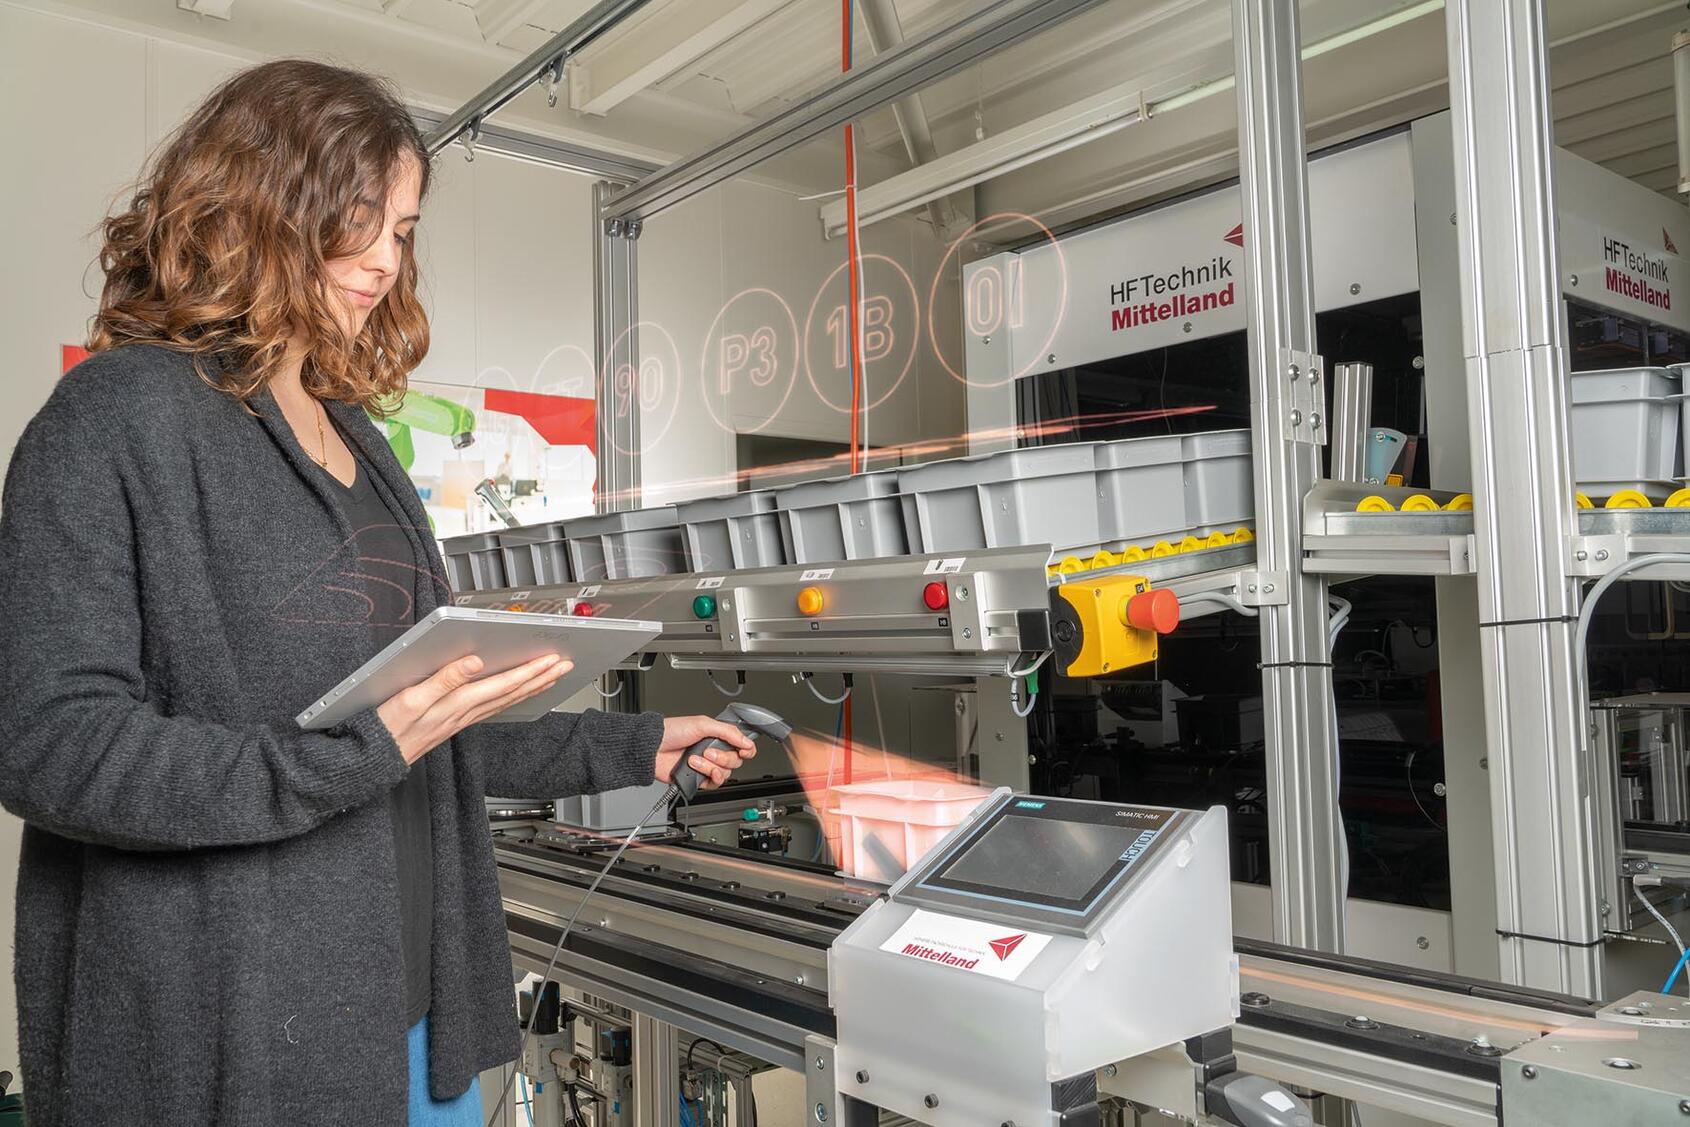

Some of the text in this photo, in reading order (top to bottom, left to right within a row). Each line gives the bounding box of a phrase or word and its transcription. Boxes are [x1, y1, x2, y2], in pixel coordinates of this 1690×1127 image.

[1605, 266, 1671, 311] Mittelland
[1111, 282, 1235, 332] Mittelland
[1115, 810, 1145, 820] SIMATIC
[1121, 830, 1157, 861] TOUCH
[901, 943, 980, 970] Mittelland
